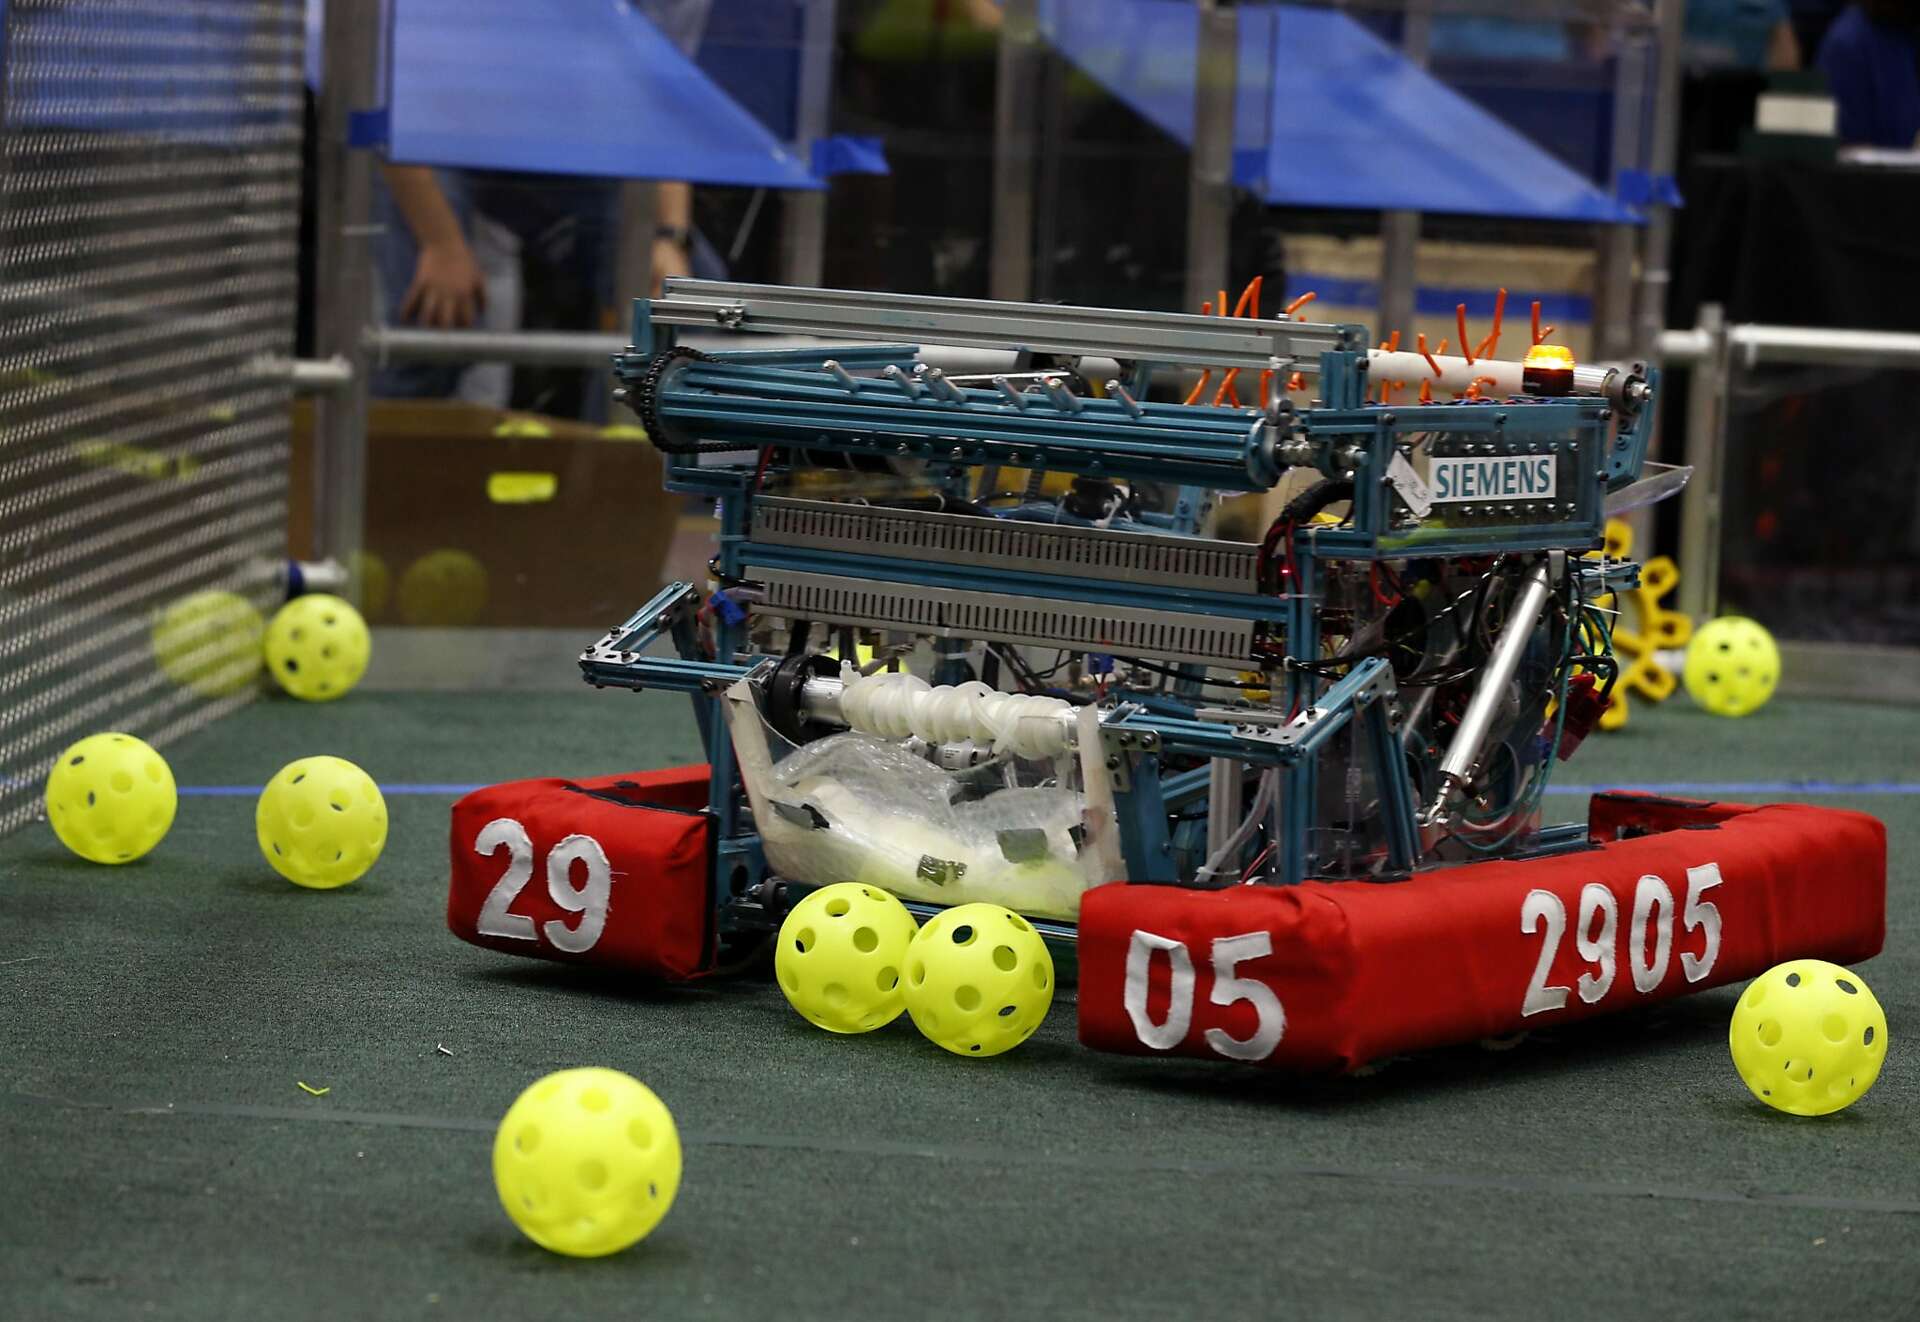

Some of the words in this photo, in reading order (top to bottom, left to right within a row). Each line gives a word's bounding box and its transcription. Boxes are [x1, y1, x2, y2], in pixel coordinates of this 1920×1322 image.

[1436, 459, 1550, 499] SIEMENS
[475, 818, 612, 952] 29
[1521, 863, 1723, 1017] 2905
[1125, 930, 1286, 1060] 05
